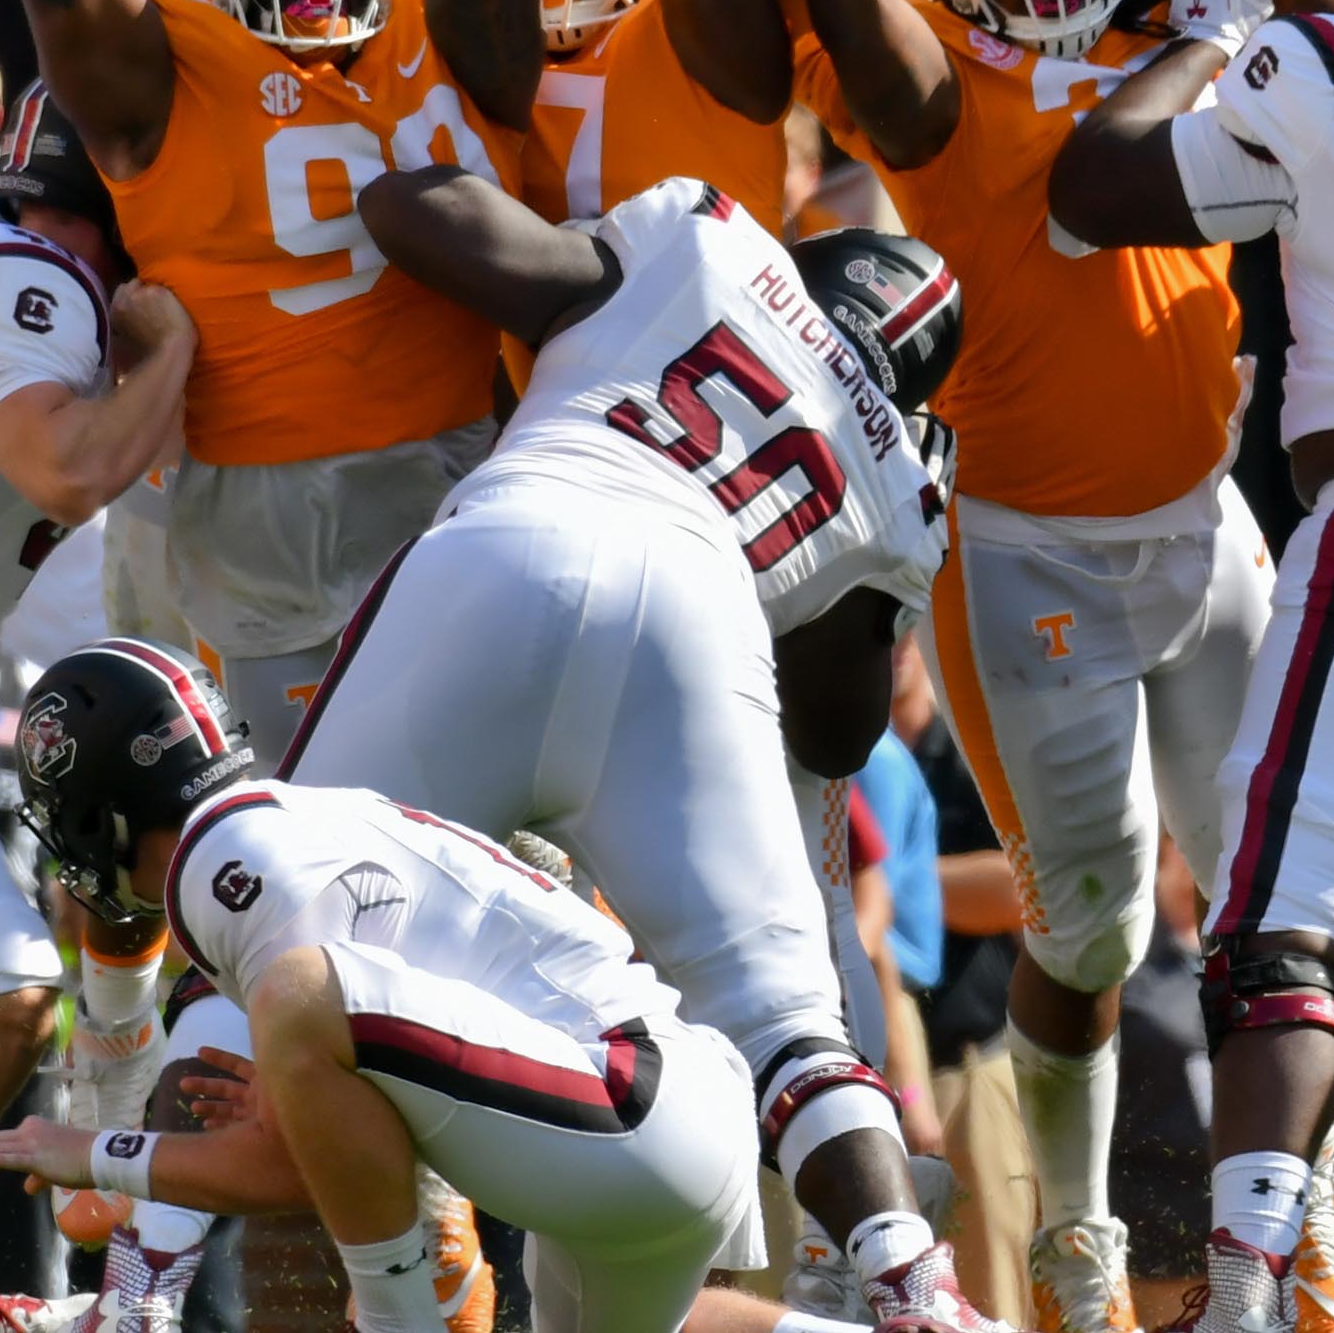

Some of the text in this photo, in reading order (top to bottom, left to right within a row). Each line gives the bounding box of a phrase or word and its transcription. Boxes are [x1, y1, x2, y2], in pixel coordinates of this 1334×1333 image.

[259, 72, 301, 116] SEC
[750, 263, 898, 463] HUTCHERSON
[833, 305, 896, 396] GAMECOCKS
[606, 320, 848, 574] 50
[1034, 610, 1074, 660] T
[790, 1064, 852, 1095] DONJOY
